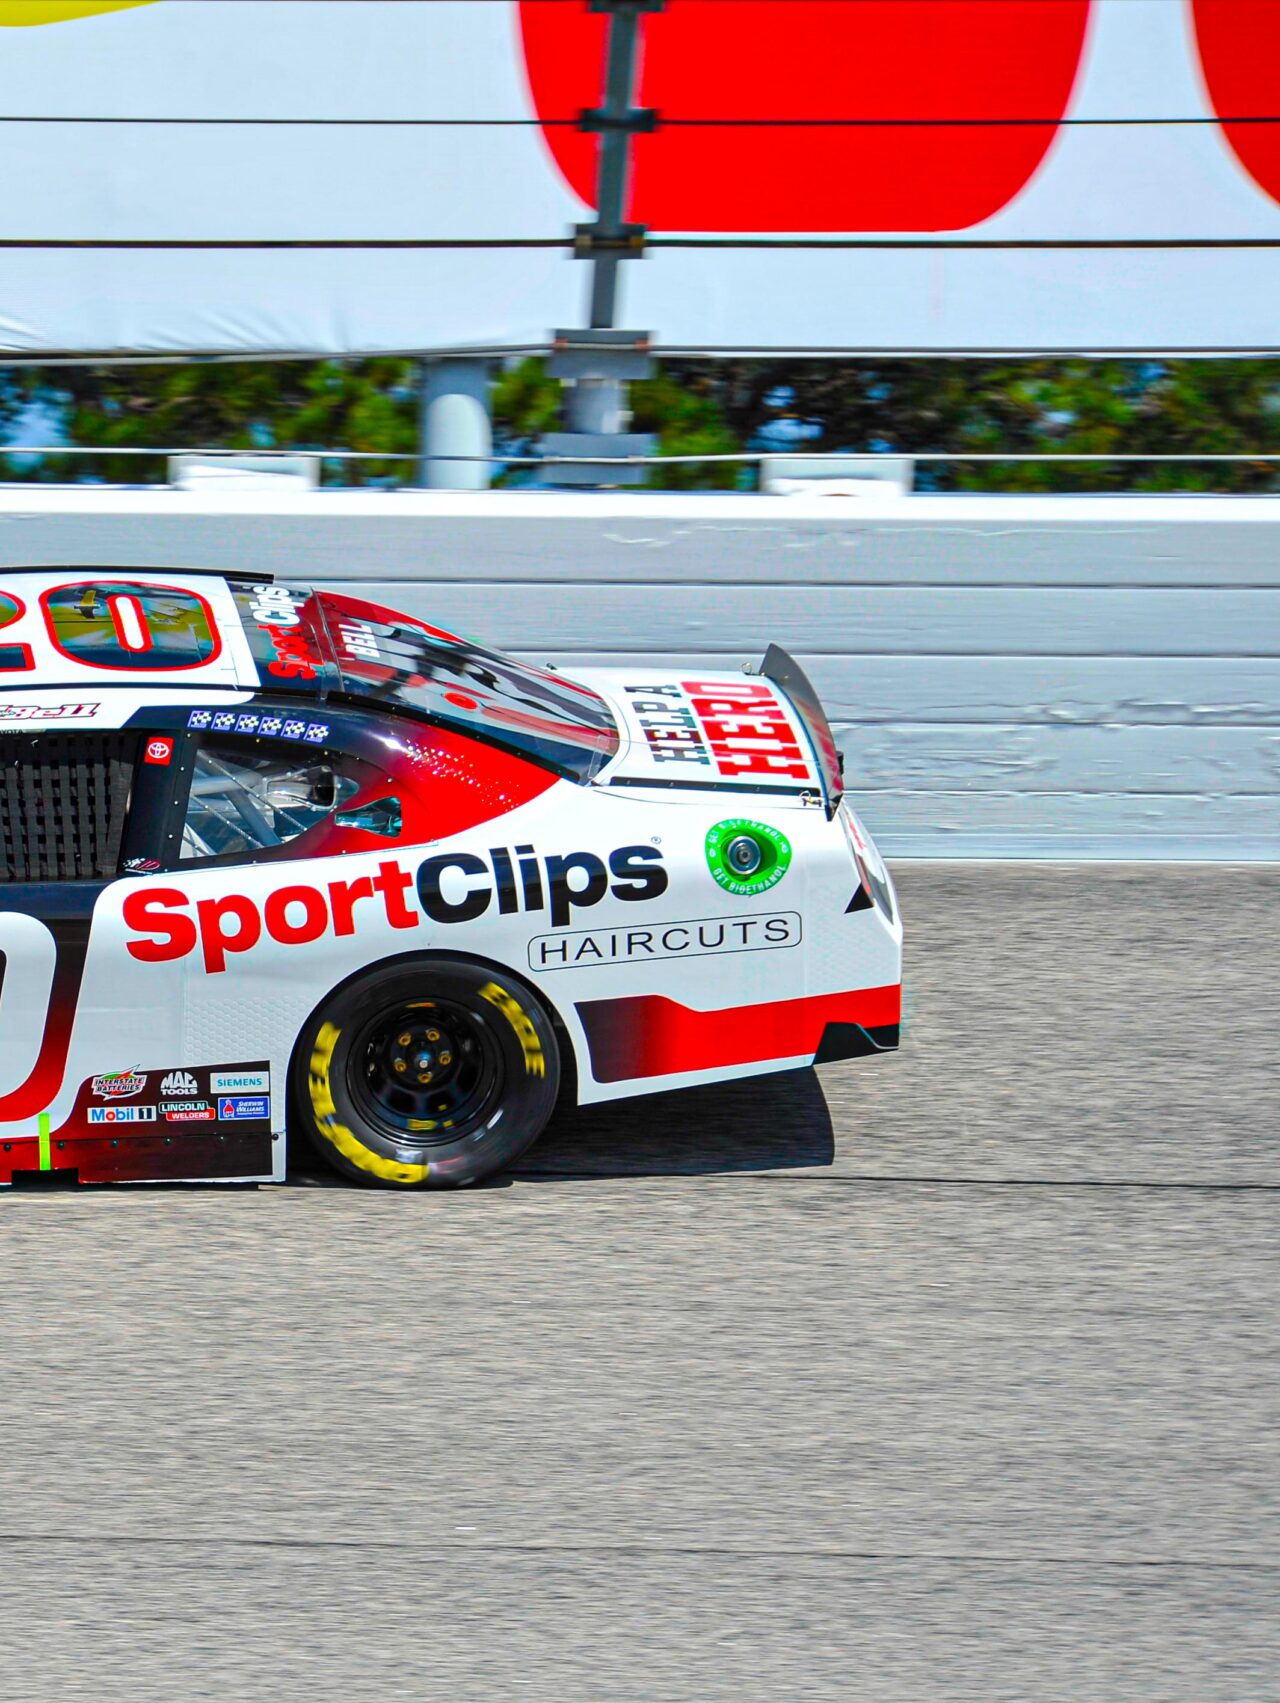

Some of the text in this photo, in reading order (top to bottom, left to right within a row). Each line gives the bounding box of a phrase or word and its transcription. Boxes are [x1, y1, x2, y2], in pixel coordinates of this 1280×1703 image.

[339, 624, 380, 658] BELL
[624, 684, 710, 765] HELP A
[680, 681, 810, 779] HERO
[540, 919, 790, 964] HAIRCUTS
[95, 1077, 144, 1085] INTERSTATE
[161, 1071, 198, 1089] MAC
[217, 1078, 263, 1087] SIEMENS
[95, 1084, 140, 1092] BATTERIES
[91, 1108, 134, 1121] Mobil
[161, 1102, 206, 1112] LINCOLN
